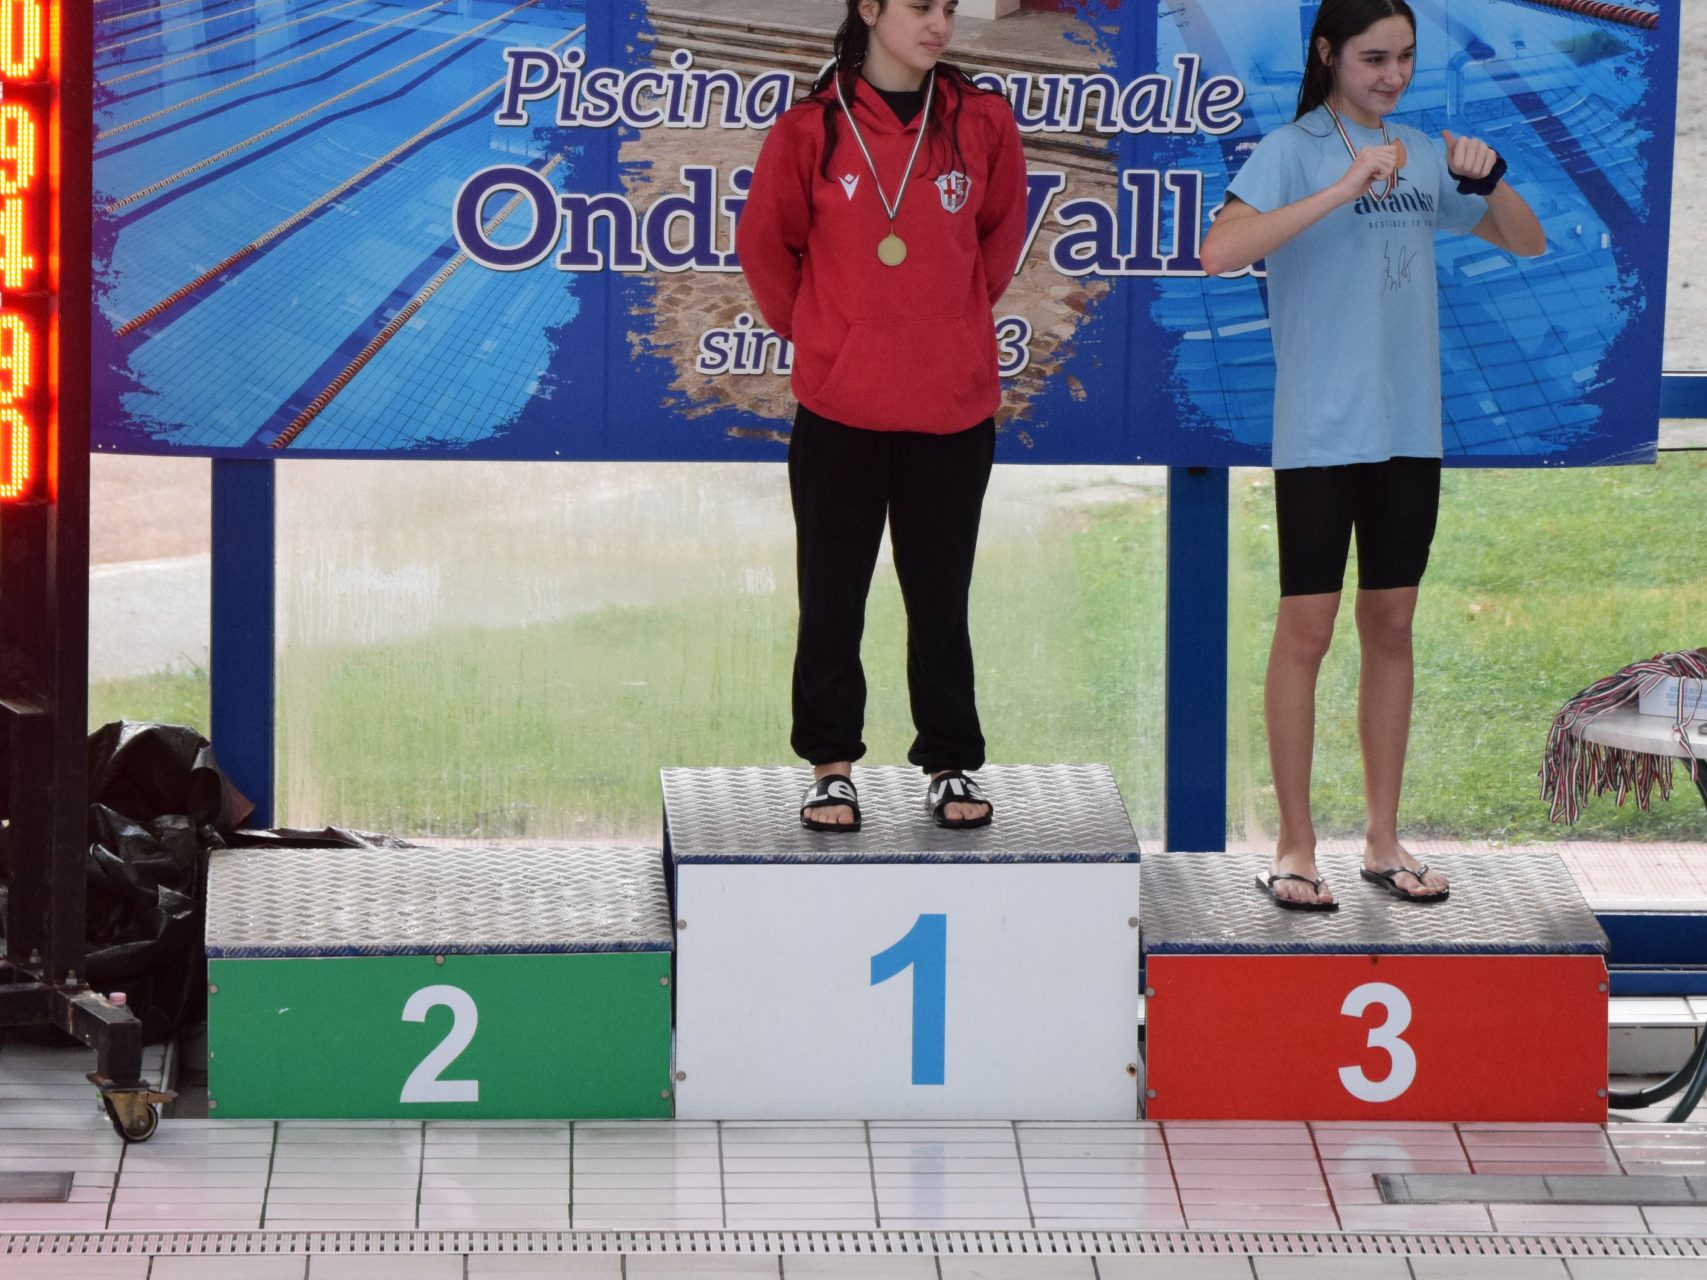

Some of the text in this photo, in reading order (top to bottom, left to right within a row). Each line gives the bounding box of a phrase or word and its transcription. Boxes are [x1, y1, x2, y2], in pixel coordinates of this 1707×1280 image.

[494, 47, 1244, 135] Piscina unale
[452, 164, 754, 273] Ondi
[696, 312, 795, 375] sin
[400, 985, 478, 1102] 2
[870, 913, 947, 1085] 1
[1339, 983, 1416, 1102] 3
